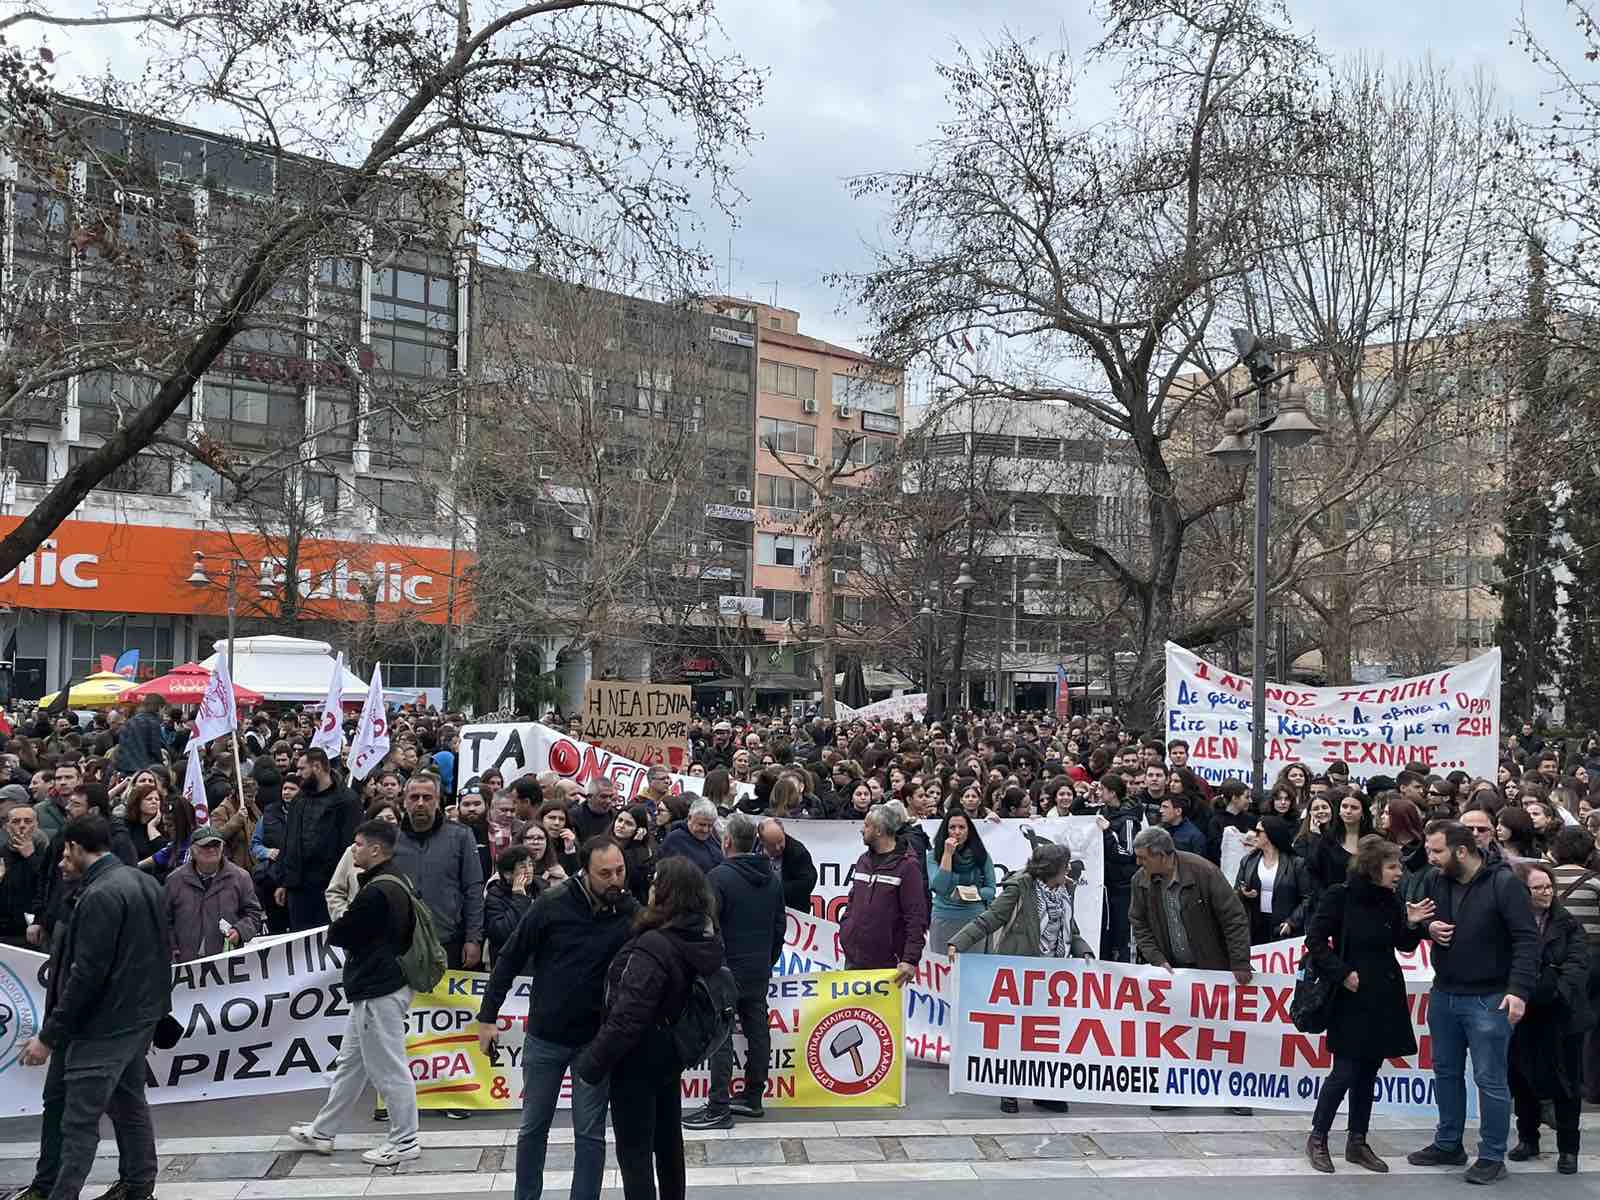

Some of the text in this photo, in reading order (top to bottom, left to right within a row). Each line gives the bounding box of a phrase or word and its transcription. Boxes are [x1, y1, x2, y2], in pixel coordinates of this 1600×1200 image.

[589, 687, 691, 717] Η ΝΕΑ ΓΕΝΙΑ
[1177, 680, 1199, 705] Δε
[584, 718, 617, 738] ΔΕΝ
[1169, 710, 1207, 732] Είτε
[1219, 719, 1239, 735] με
[1335, 726, 1370, 738] τους
[1403, 723, 1426, 742] με
[1432, 723, 1450, 735] τη
[463, 728, 526, 773] ΤΑ
[1192, 735, 1239, 760] ΔΕΝ
[1265, 736, 1301, 763] ΑΣ
[832, 980, 890, 999] μας
[988, 968, 1172, 1015] ΑΓΩΝΑΣ
[1190, 982, 1292, 1023] ΜΕΧ
[182, 983, 351, 1039] ΛΟΓΟΣ
[854, 1009, 888, 1037] ΚΕΝΤΡΟ
[969, 1011, 1247, 1065] ΤΕΛΙΚΗ
[408, 1053, 471, 1081] ΩΡΑ
[967, 1055, 1160, 1094] ΠΛΗΜΜΥΡΟΠΑΘΕΙΣ
[1165, 1067, 1223, 1096] ΑΓΙΟΥ
[1228, 1070, 1290, 1099] ΘΩΜΑ
